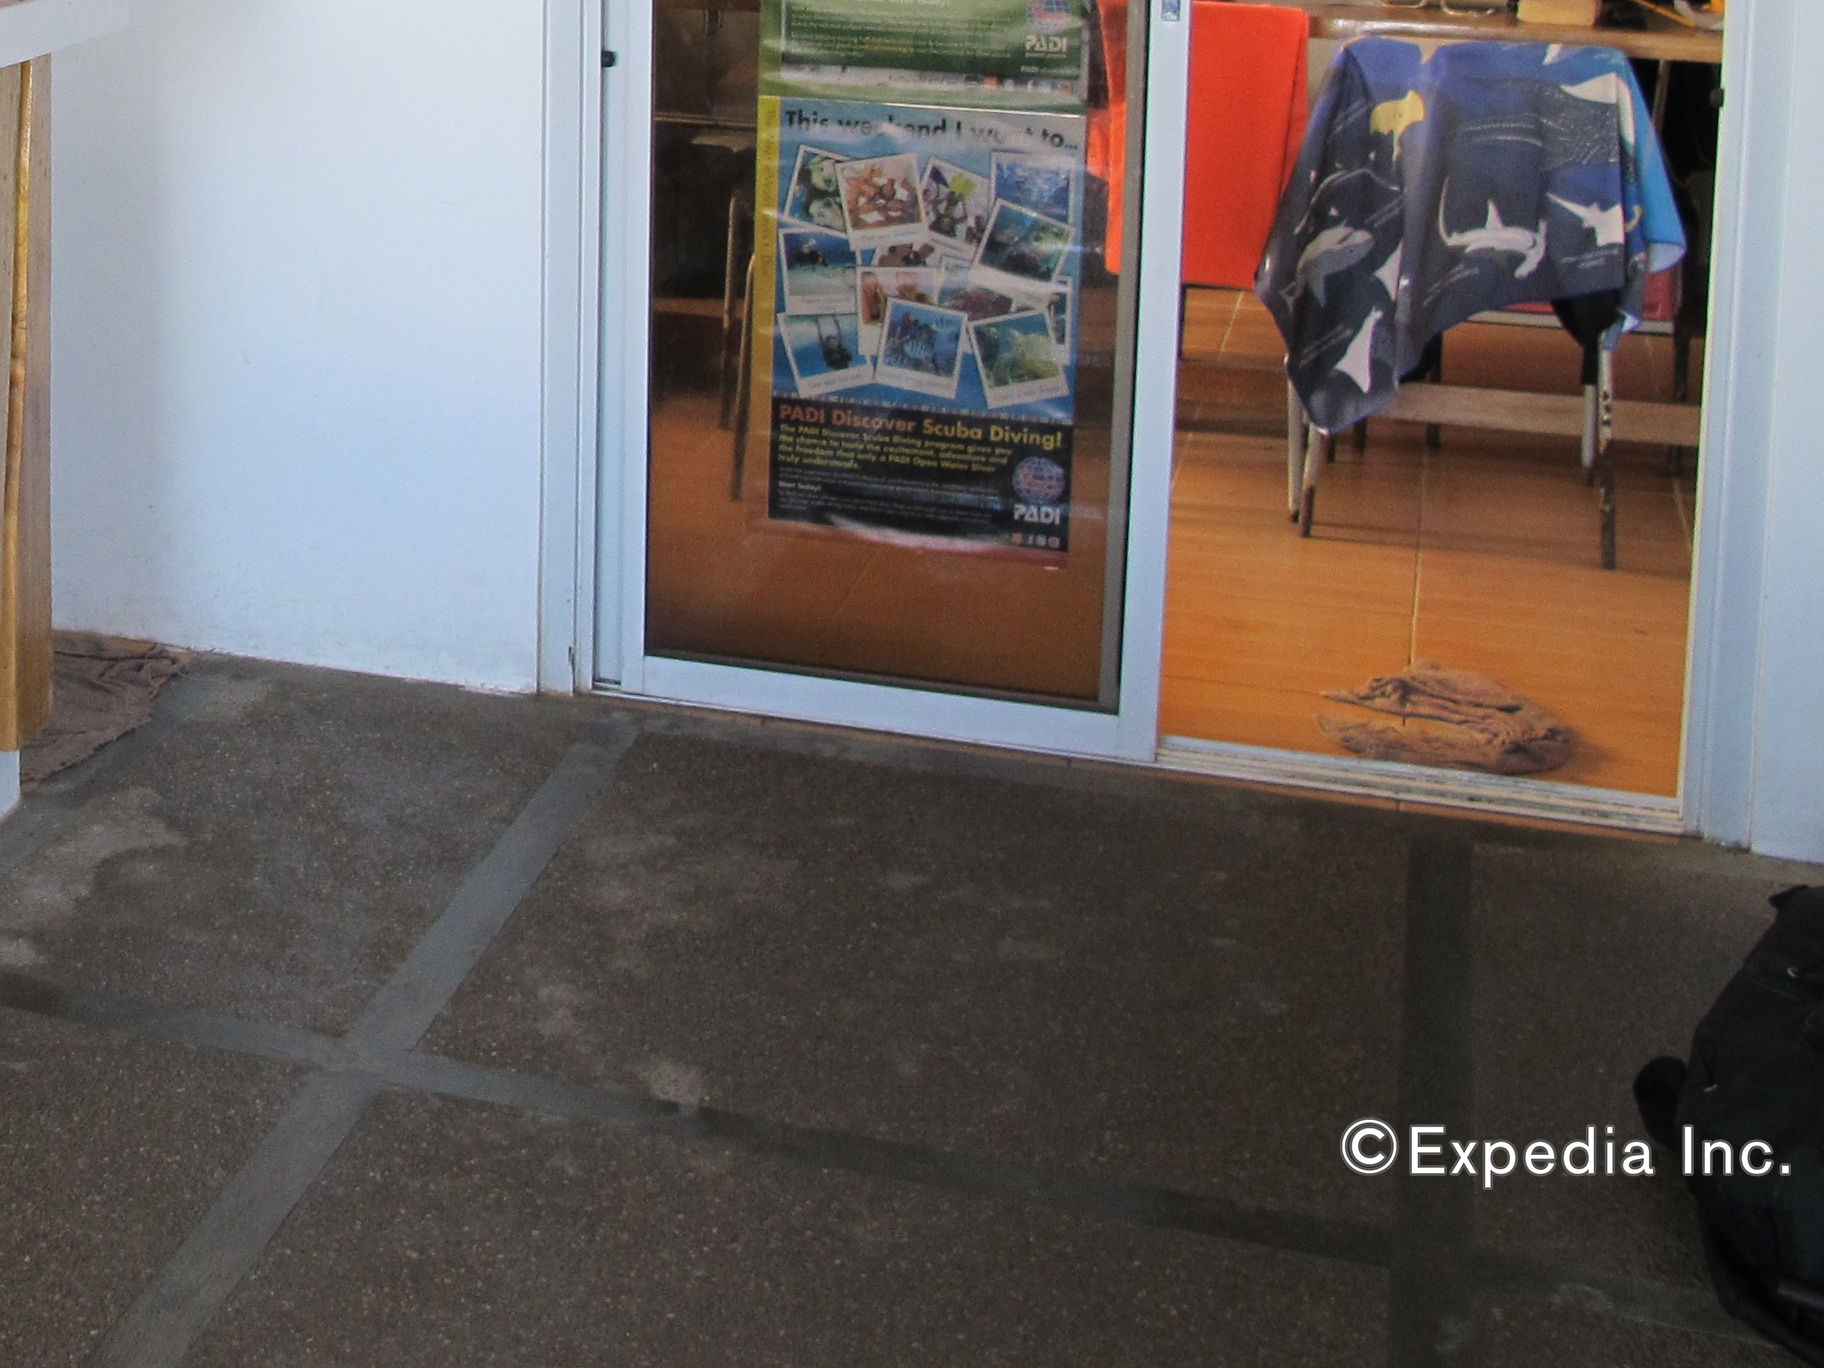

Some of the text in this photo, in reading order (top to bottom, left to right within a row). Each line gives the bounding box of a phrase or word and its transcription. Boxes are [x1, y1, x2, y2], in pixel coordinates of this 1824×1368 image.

[1026, 34, 1067, 51] PADI
[785, 110, 829, 129] This
[780, 404, 1062, 450] PADI Discover Scuba Diving!
[1014, 503, 1061, 525] PADI
